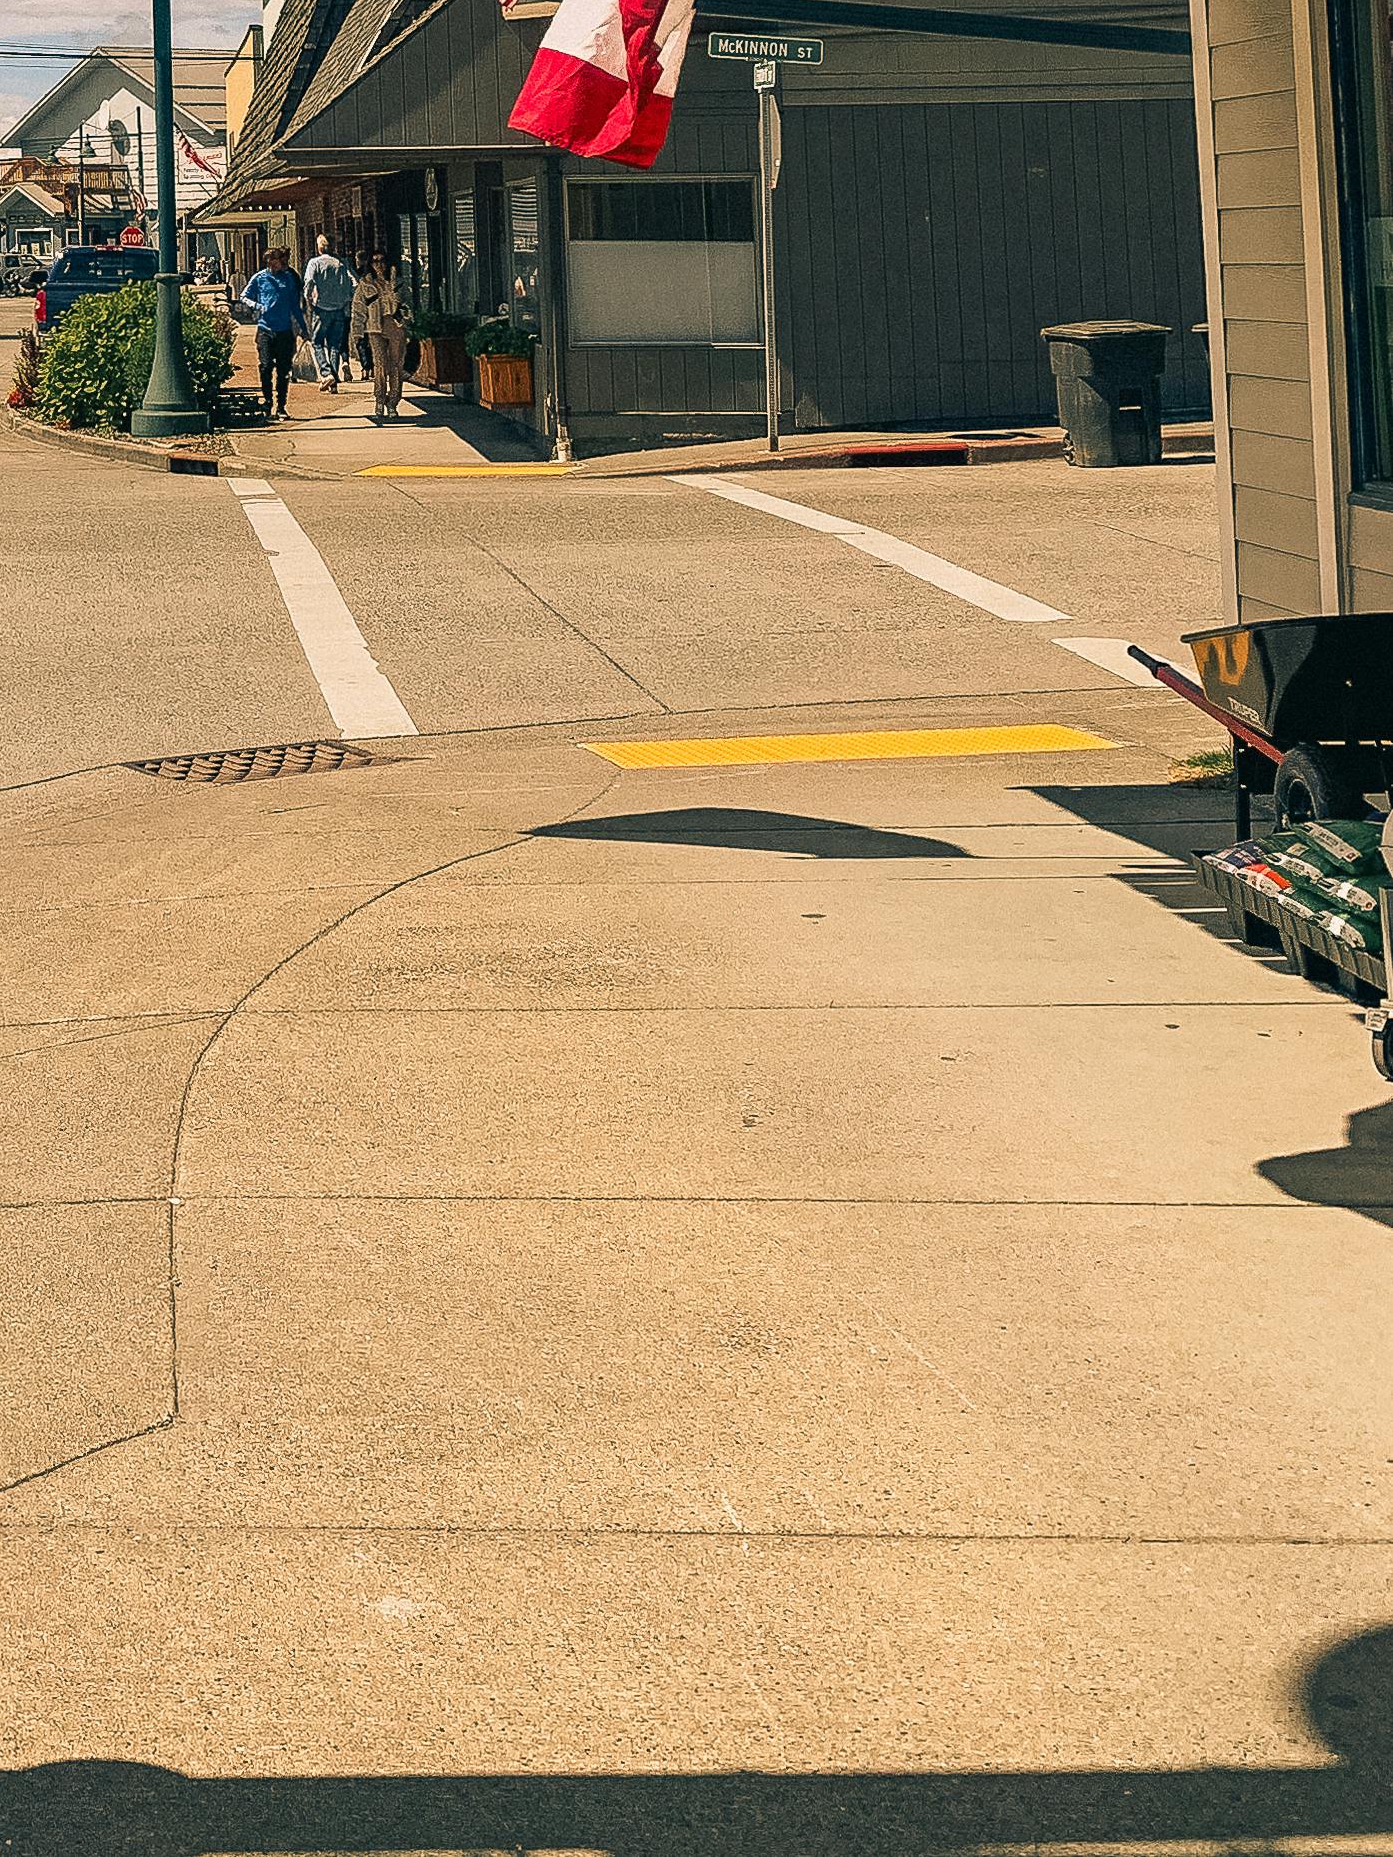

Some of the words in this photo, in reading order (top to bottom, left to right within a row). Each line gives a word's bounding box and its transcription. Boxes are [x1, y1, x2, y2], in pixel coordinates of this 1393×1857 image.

[718, 39, 788, 57] McKINNON
[797, 47, 814, 59] ST
[121, 233, 144, 245] STOP
